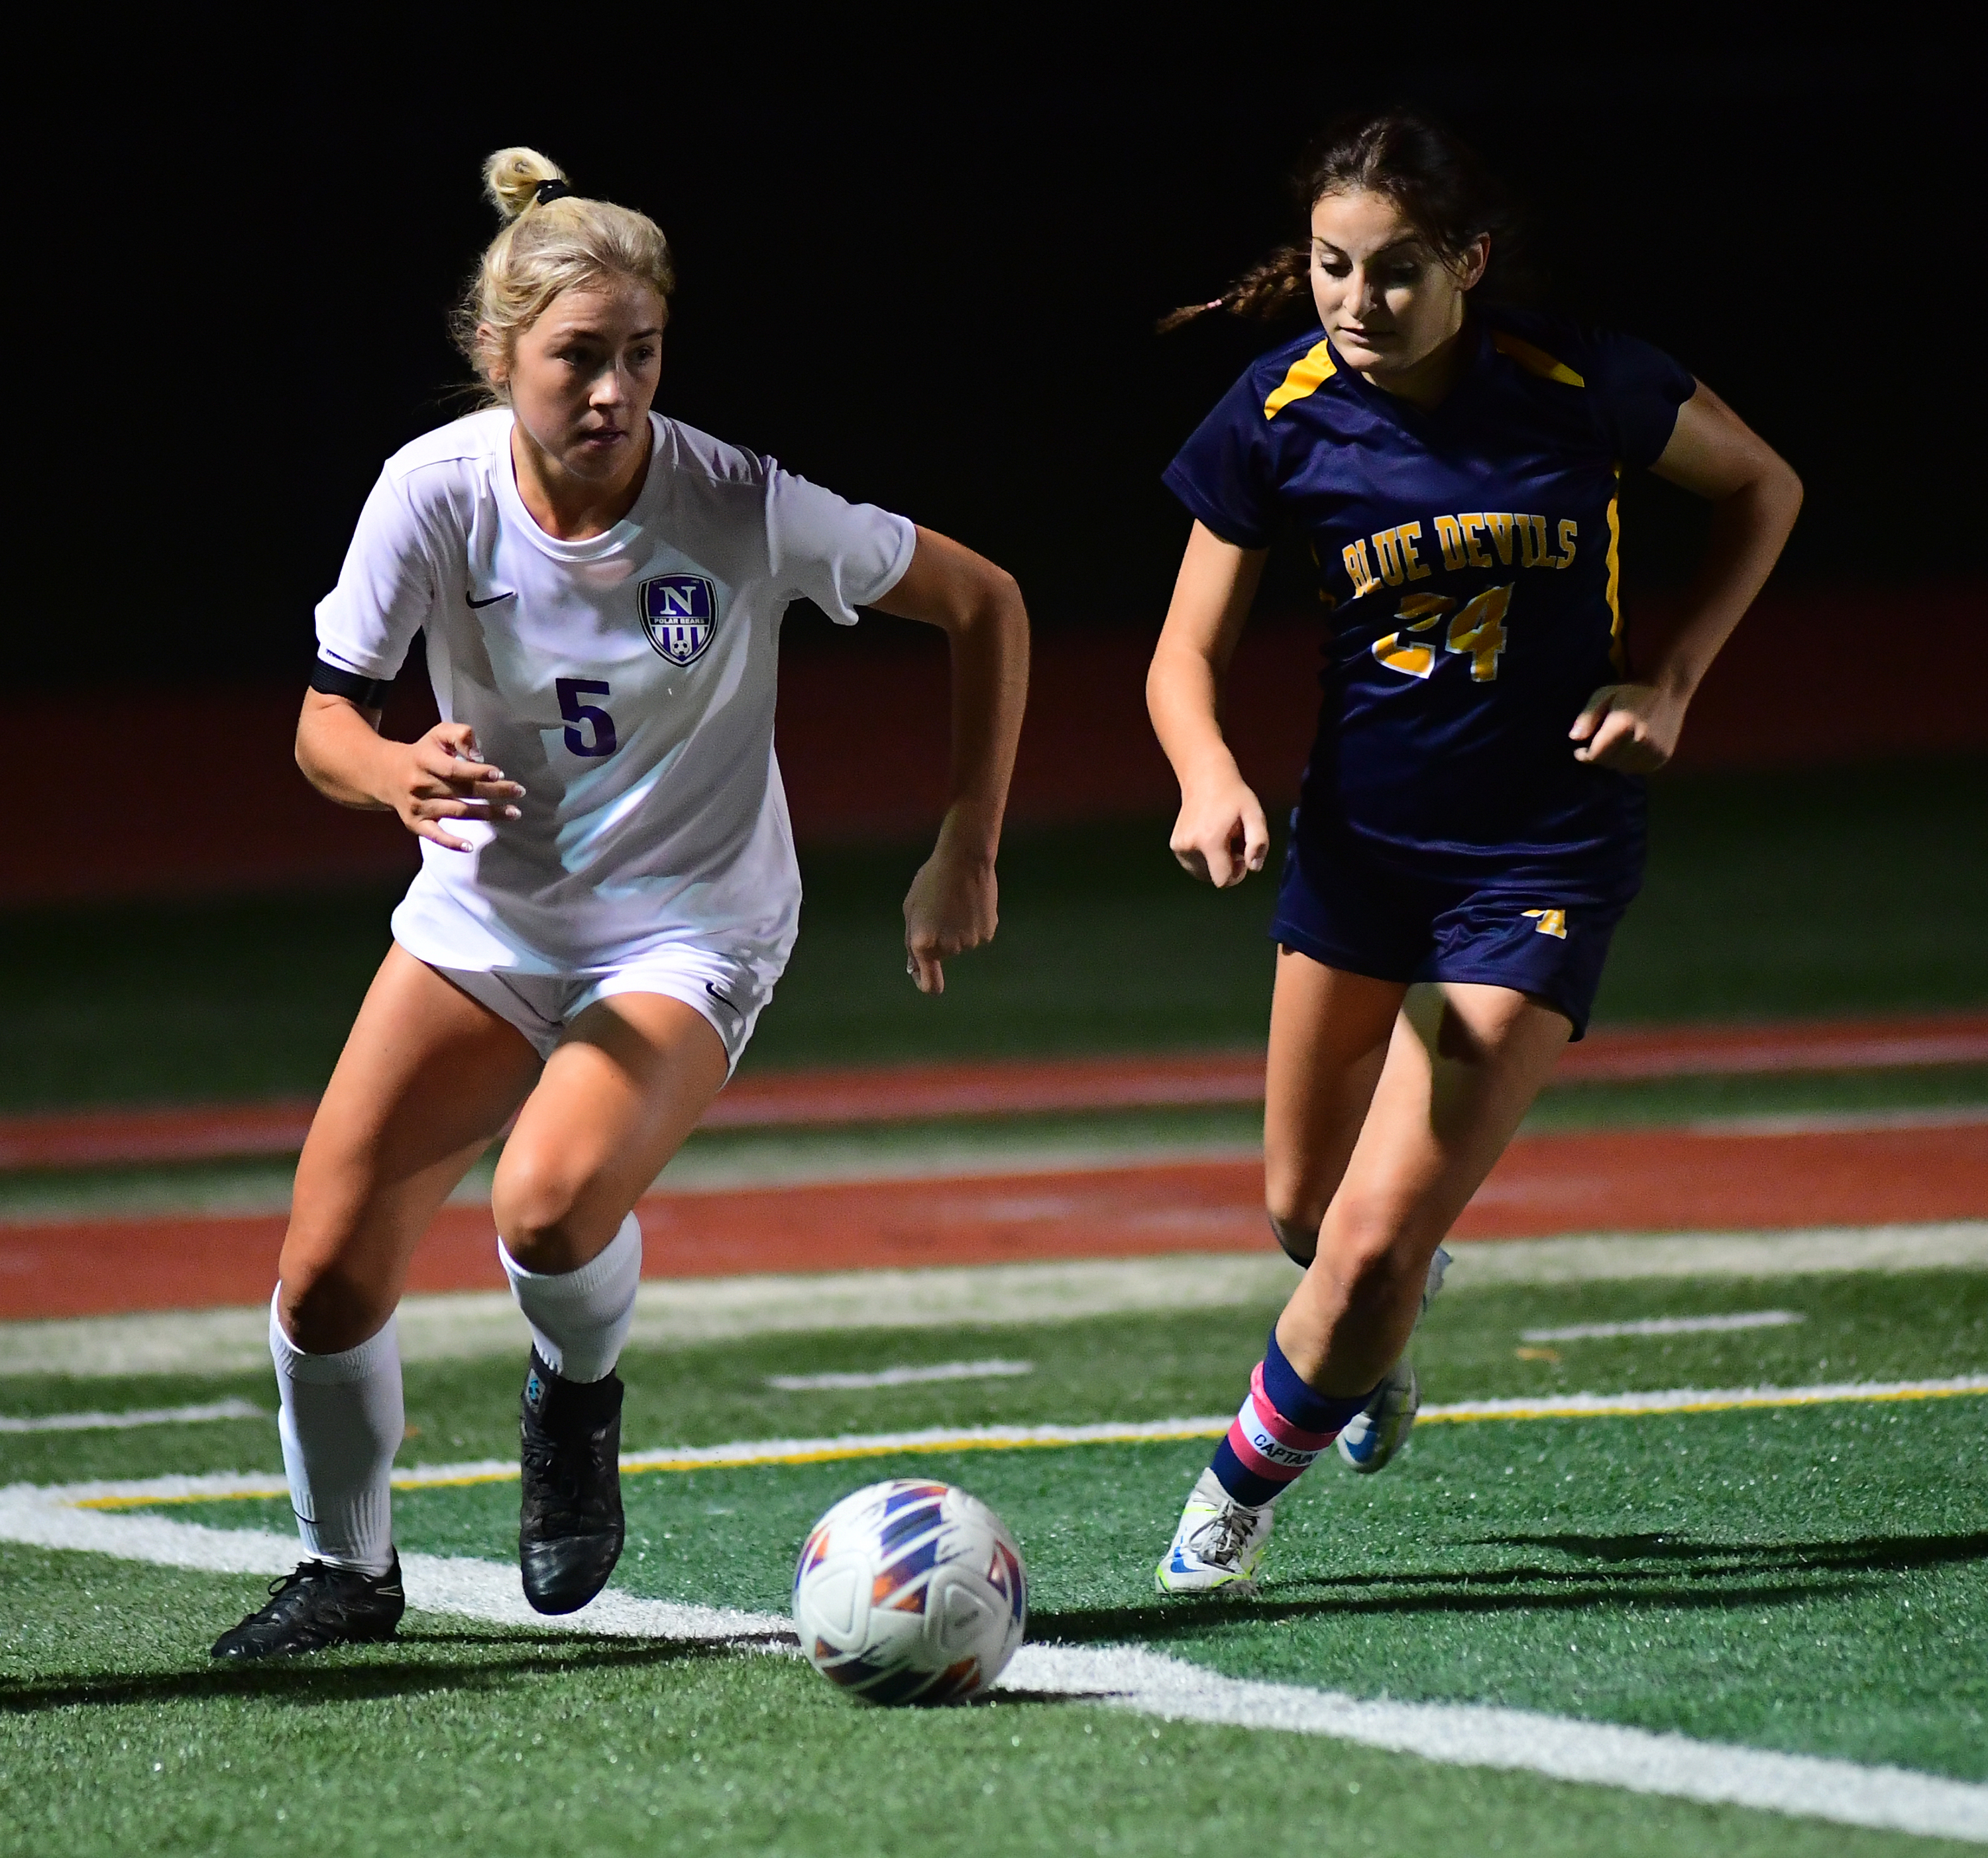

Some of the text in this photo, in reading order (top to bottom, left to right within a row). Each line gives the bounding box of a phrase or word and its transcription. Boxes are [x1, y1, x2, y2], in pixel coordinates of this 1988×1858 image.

[1342, 512, 1577, 599] BLUE DEVILS
[659, 586, 696, 615] N
[1372, 582, 1516, 683] 24
[555, 678, 617, 757] 5
